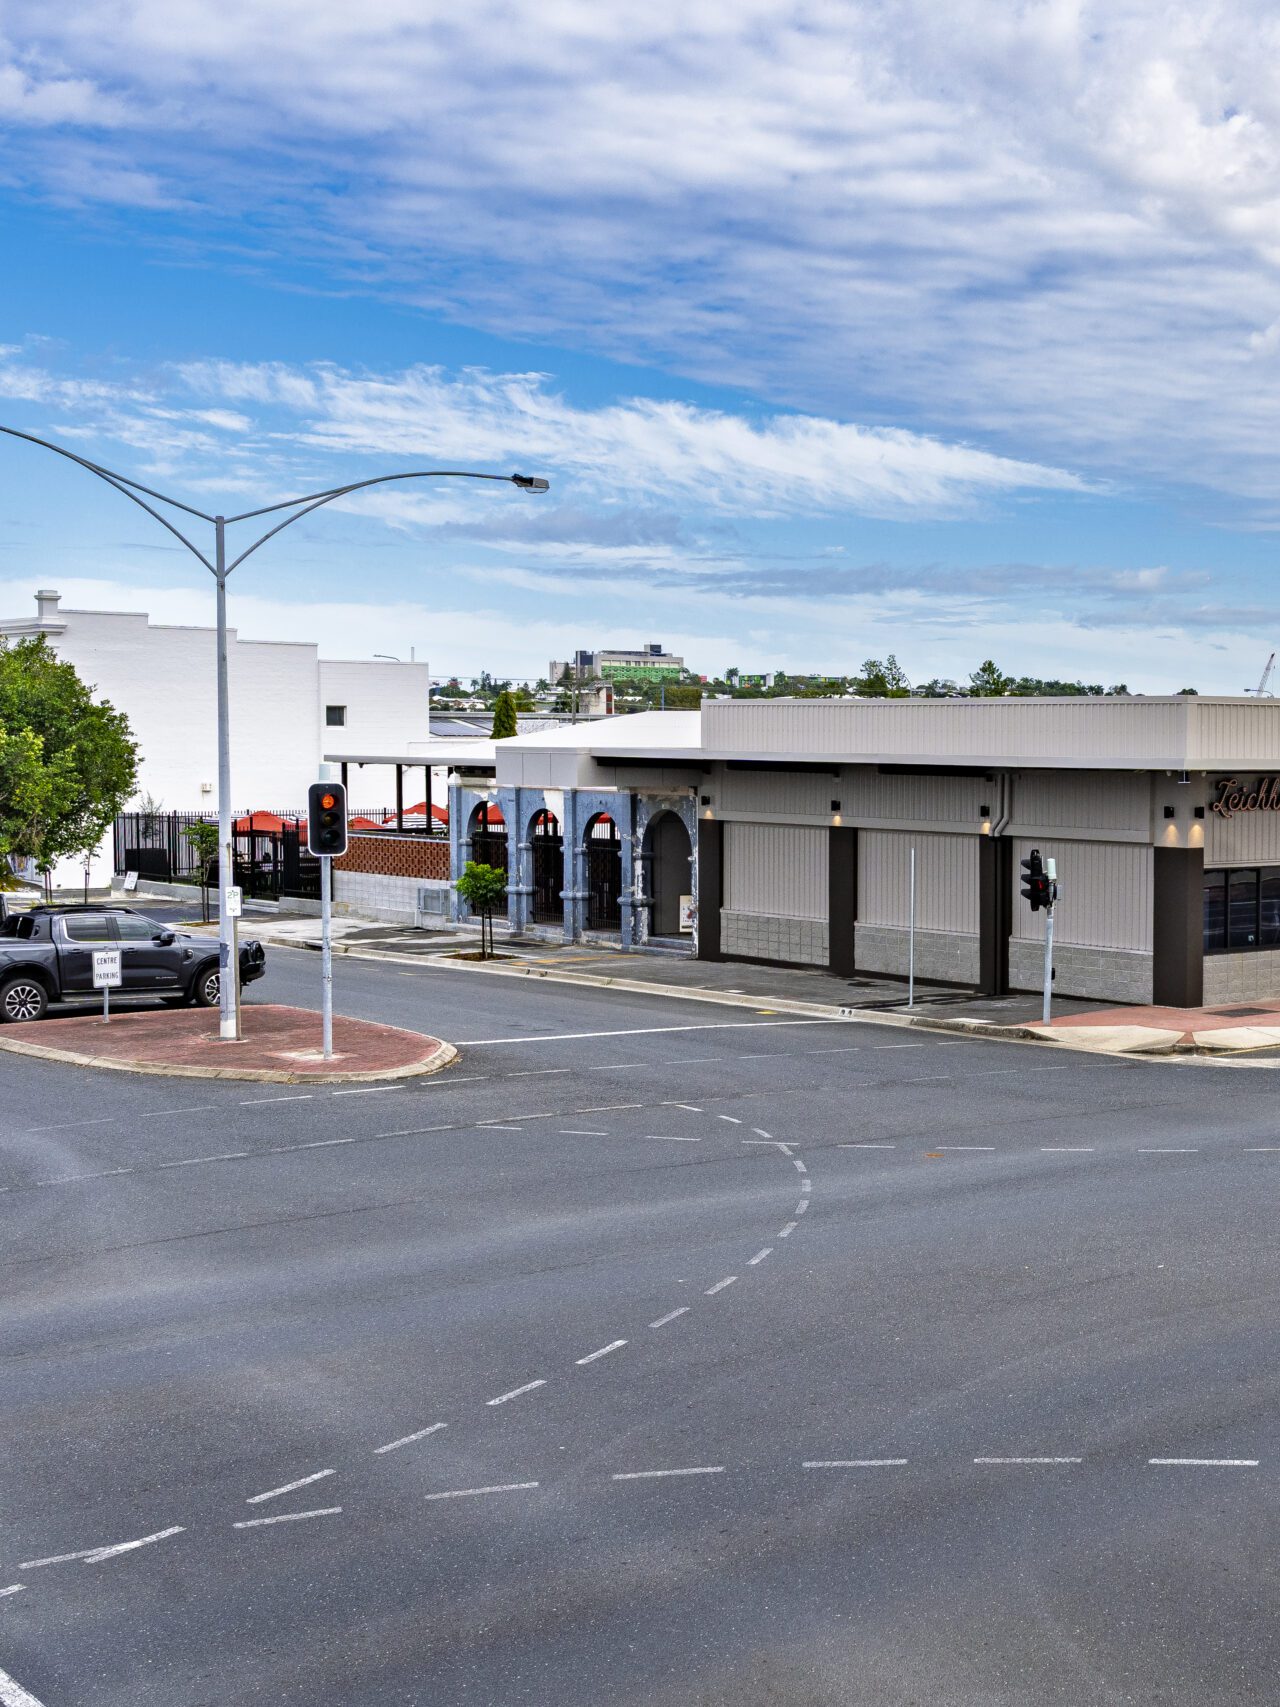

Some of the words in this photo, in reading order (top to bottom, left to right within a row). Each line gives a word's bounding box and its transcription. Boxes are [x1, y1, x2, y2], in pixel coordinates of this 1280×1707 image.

[227, 891, 239, 899] 2P
[96, 957, 118, 965] CENTRE
[96, 972, 119, 980] PARKING
